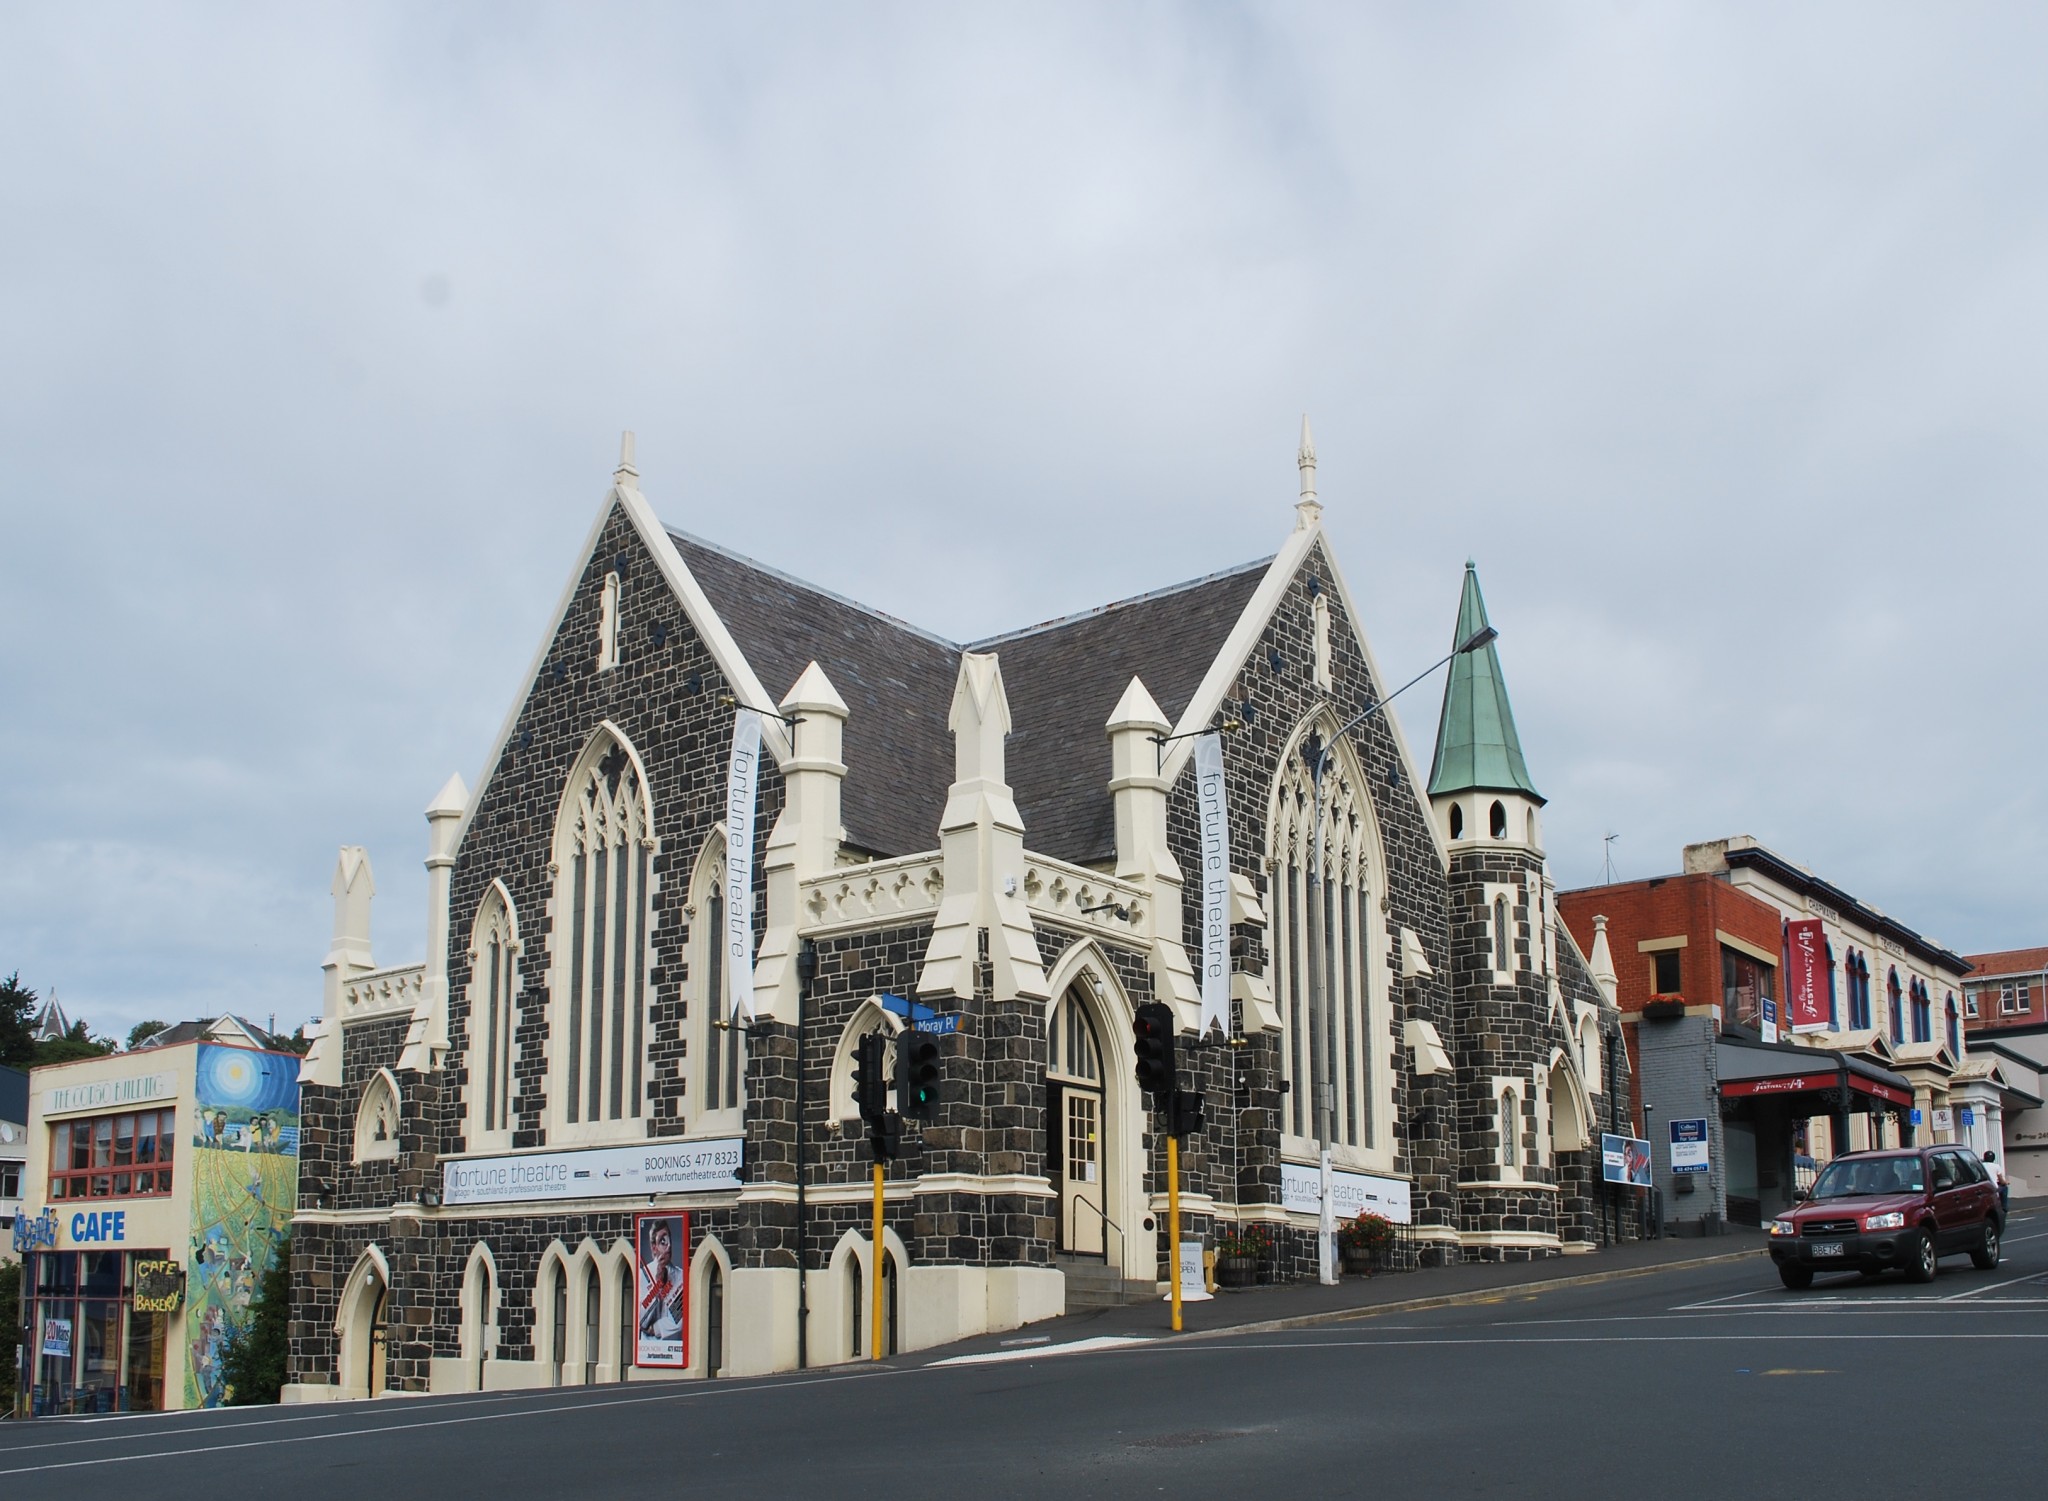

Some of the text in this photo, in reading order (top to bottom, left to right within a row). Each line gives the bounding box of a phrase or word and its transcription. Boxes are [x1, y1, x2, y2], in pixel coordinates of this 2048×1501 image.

[730, 749, 754, 958] fortune theatre
[1202, 772, 1226, 979] fortune theatre
[1802, 966, 1818, 1018] FESTIVAL
[918, 1016, 954, 1034] Moray Pl
[53, 1089, 70, 1110] THE
[73, 1082, 112, 1107] CORSO
[645, 1150, 738, 1171] BOOKINGS 477 8323
[455, 1165, 507, 1187] fortune
[511, 1162, 567, 1184] theatre
[1281, 1176, 1364, 1202] ortune eatre
[71, 1211, 125, 1242] CAFE
[138, 1260, 177, 1278] CAFE
[136, 1290, 179, 1312] BAKERY
